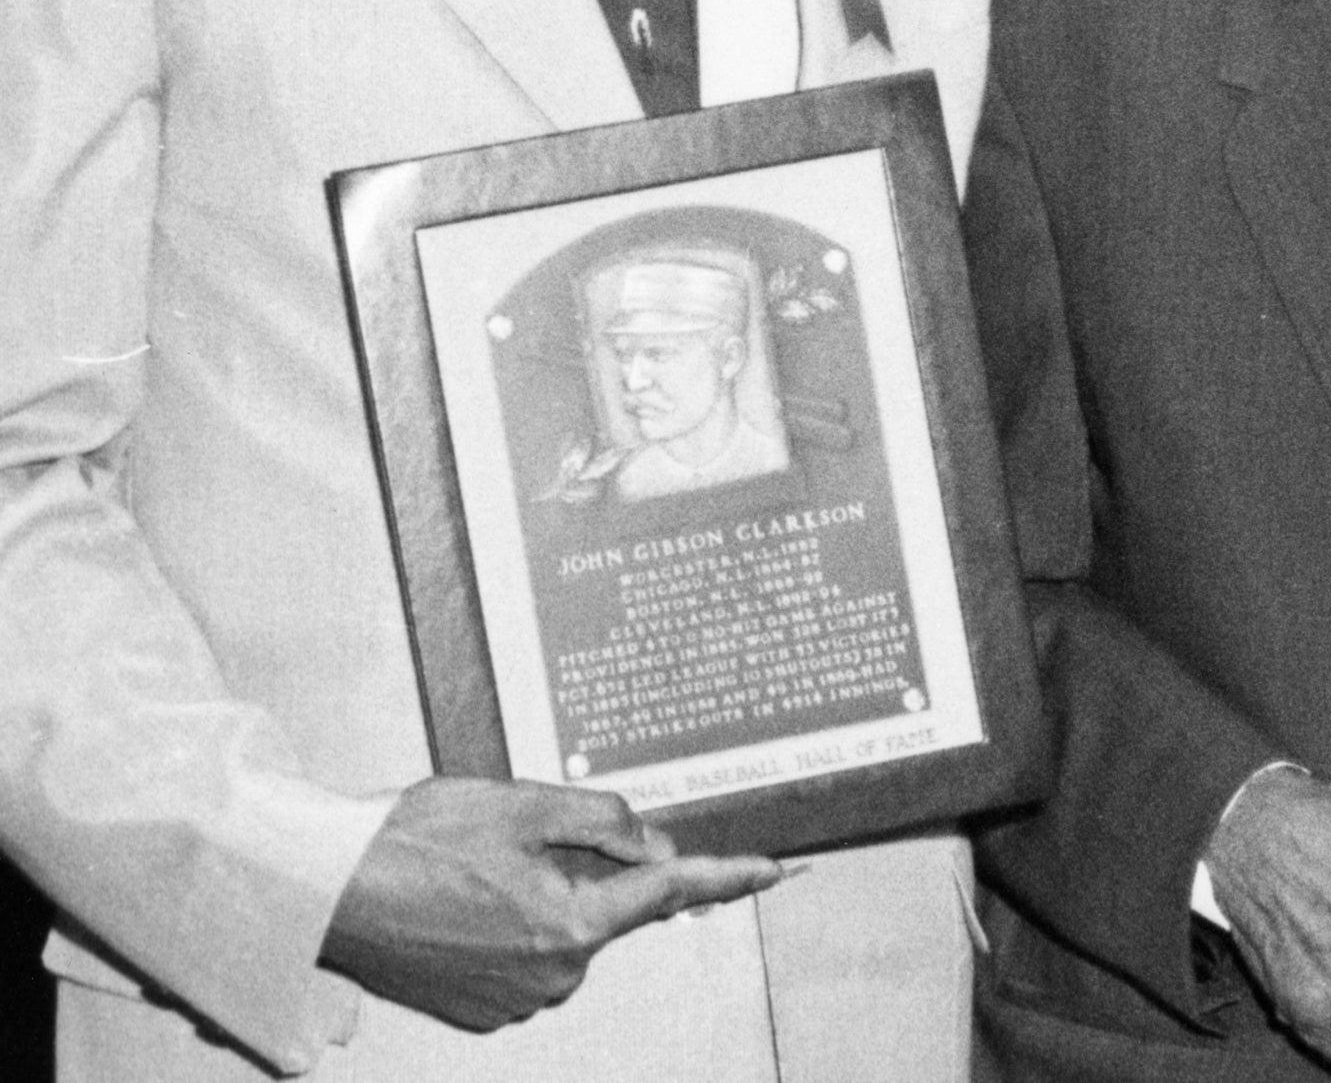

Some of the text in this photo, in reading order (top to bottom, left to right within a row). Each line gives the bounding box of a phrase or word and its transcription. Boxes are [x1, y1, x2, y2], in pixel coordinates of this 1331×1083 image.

[555, 501, 865, 577] JOHN GIBSON CLARKSON
[558, 642, 638, 667] PITCHED
[766, 608, 814, 627] GAME
[821, 592, 897, 616] AGAINST
[561, 614, 866, 683] PROVIDENCE IN WON LOST
[630, 623, 910, 689] LED LEAGUE WITH VICTORIES
[632, 674, 737, 705] (INCLUDING
[765, 650, 860, 679] SHUTOUTS)
[722, 688, 759, 706] AND
[861, 661, 897, 679] HAD
[626, 708, 743, 742] STRIKEOUTS
[687, 757, 783, 792] BASEBALL
[796, 745, 846, 771] HALL
[855, 739, 876, 759] OF
[885, 727, 939, 753] FAME
